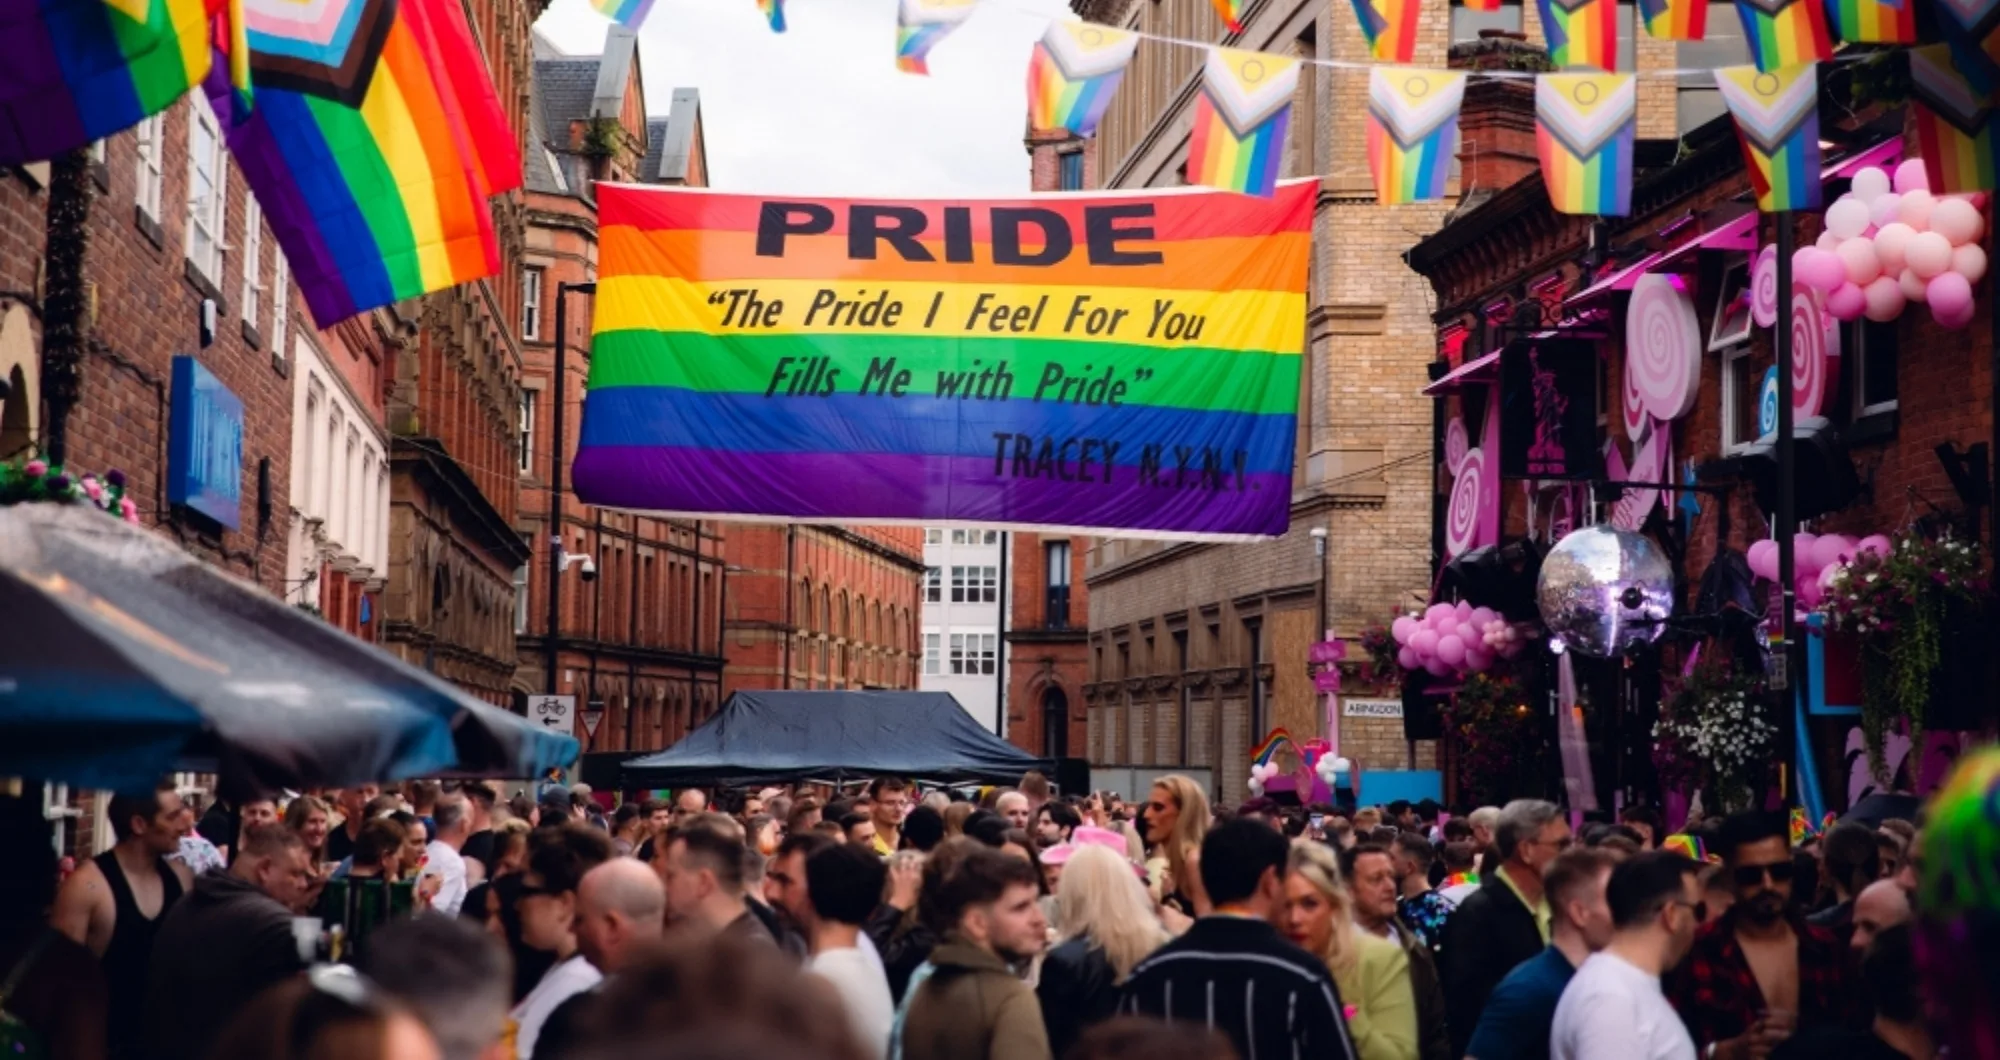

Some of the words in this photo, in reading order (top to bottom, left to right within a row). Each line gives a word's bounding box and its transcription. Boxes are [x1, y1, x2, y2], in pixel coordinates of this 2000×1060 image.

[756, 202, 1164, 267] PRIDE
[707, 289, 784, 328] “The
[803, 289, 903, 328] Pride
[923, 291, 944, 328] I
[965, 293, 1049, 332] Feel
[1063, 295, 1129, 335] For
[1146, 299, 1206, 340] You
[763, 356, 841, 398] Fills
[859, 356, 912, 398] Me
[935, 359, 1015, 401] with
[1032, 362, 1155, 407] Pride”
[993, 432, 1121, 484] TRACEY
